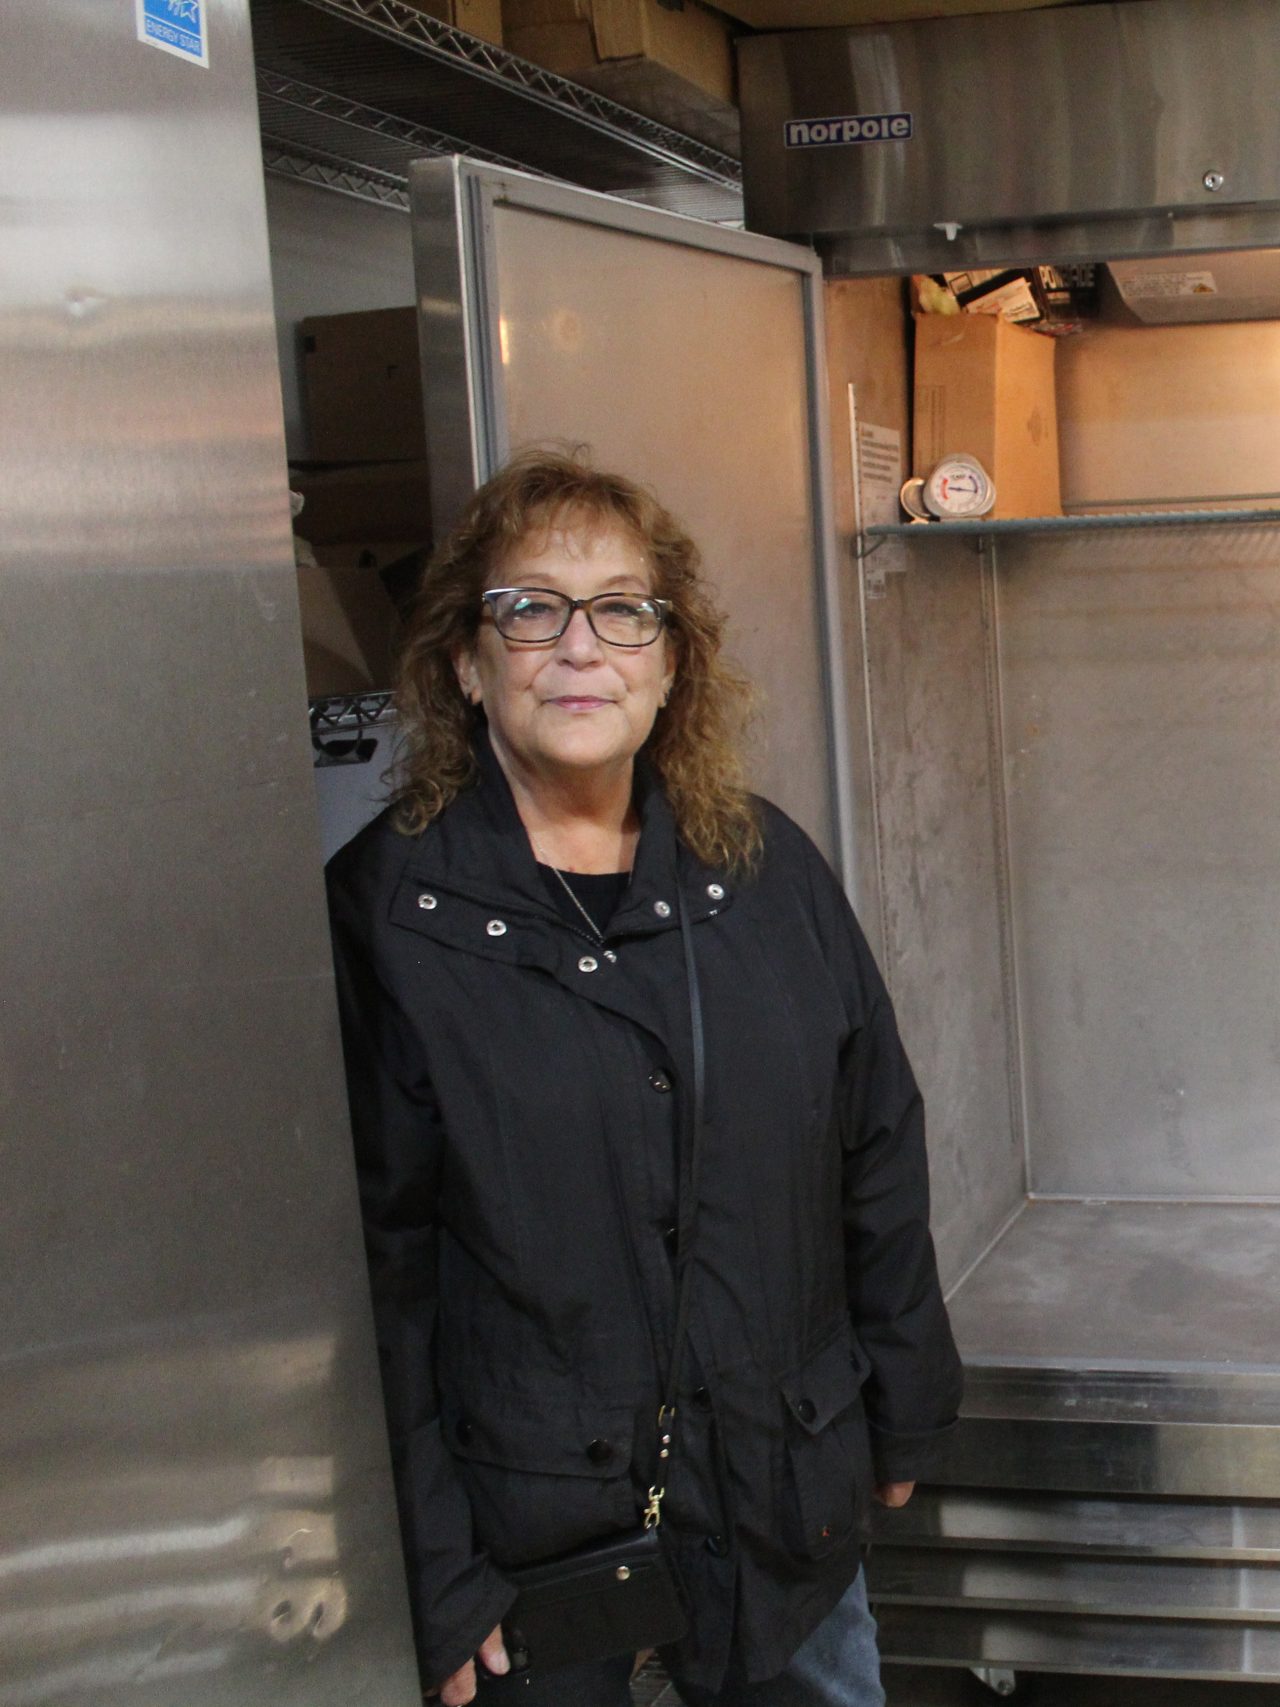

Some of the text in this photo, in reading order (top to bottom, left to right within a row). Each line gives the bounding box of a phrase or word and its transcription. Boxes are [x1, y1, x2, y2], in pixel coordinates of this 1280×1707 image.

[147, 19, 200, 53] ENERGY STAR
[789, 118, 909, 144] norpole
